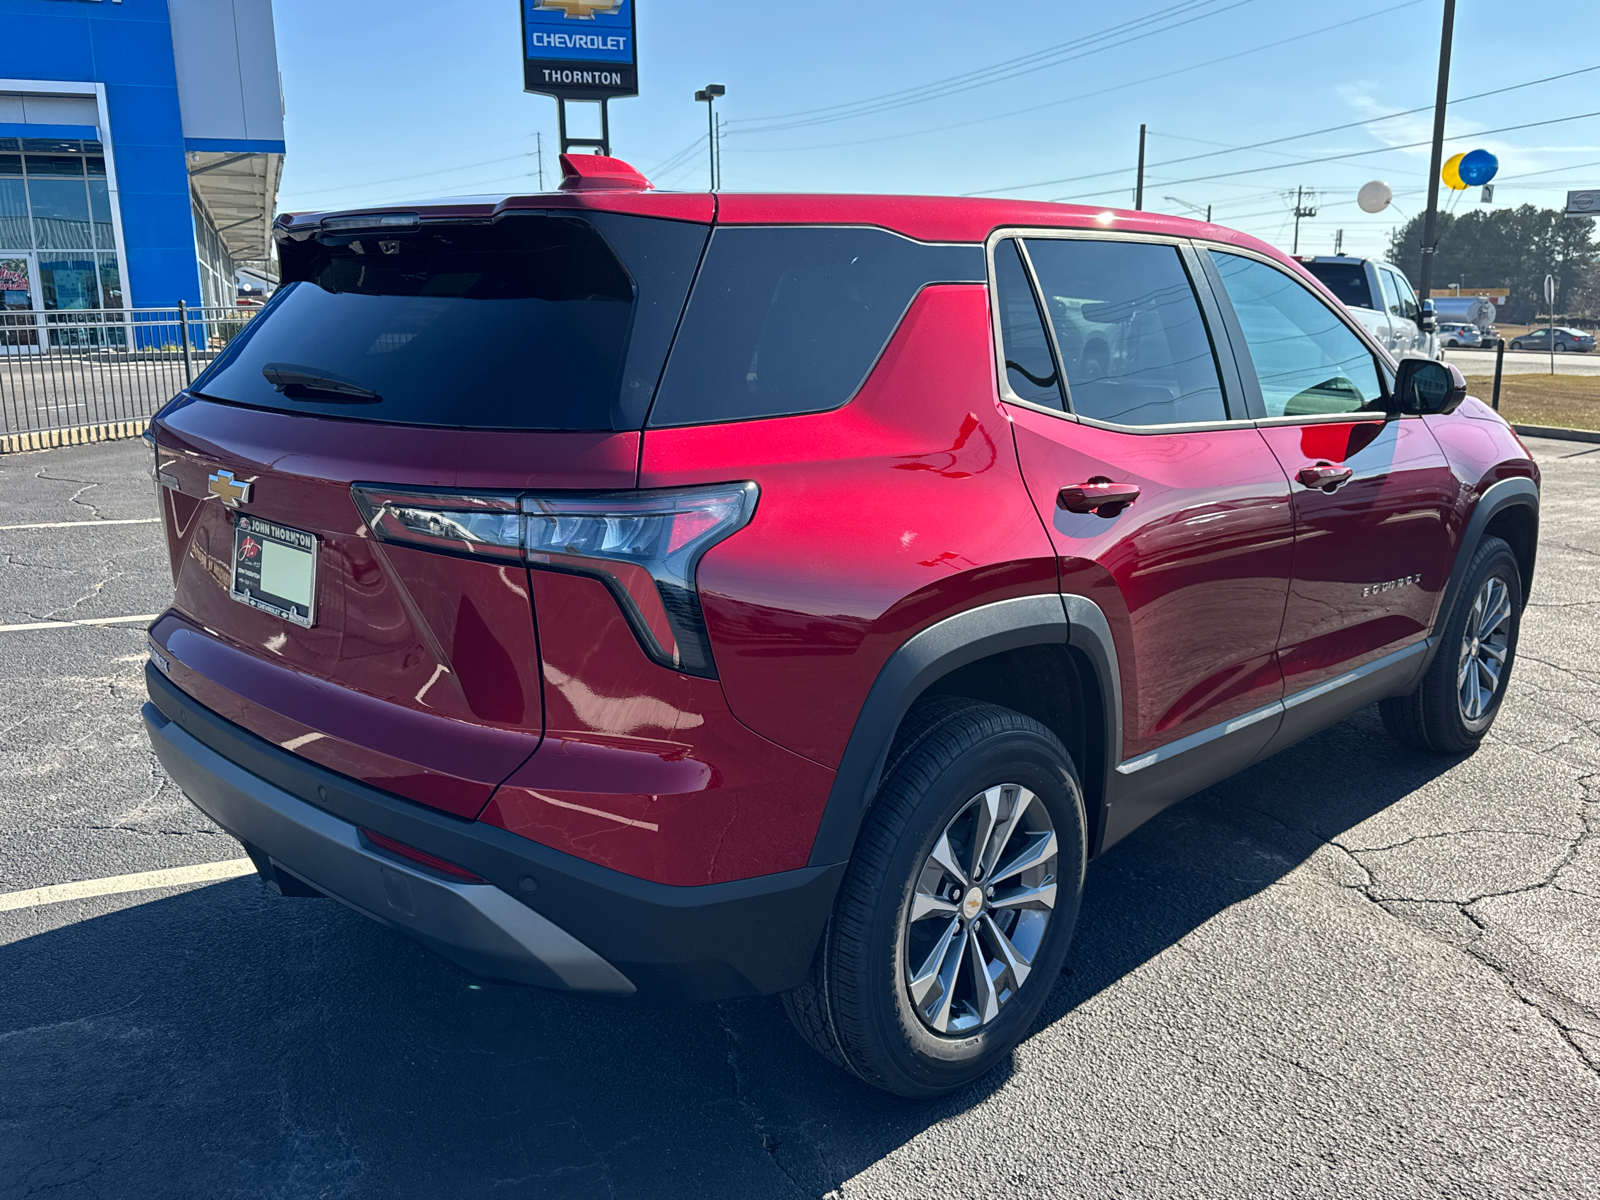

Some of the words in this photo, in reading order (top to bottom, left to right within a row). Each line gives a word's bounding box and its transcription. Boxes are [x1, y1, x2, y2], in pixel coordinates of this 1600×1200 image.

[533, 32, 626, 50] CHEVROLET
[543, 69, 621, 85] THORNTON
[251, 520, 270, 536] JOHN
[271, 526, 311, 547] THORNTON
[257, 602, 280, 616] CHEVROLET
